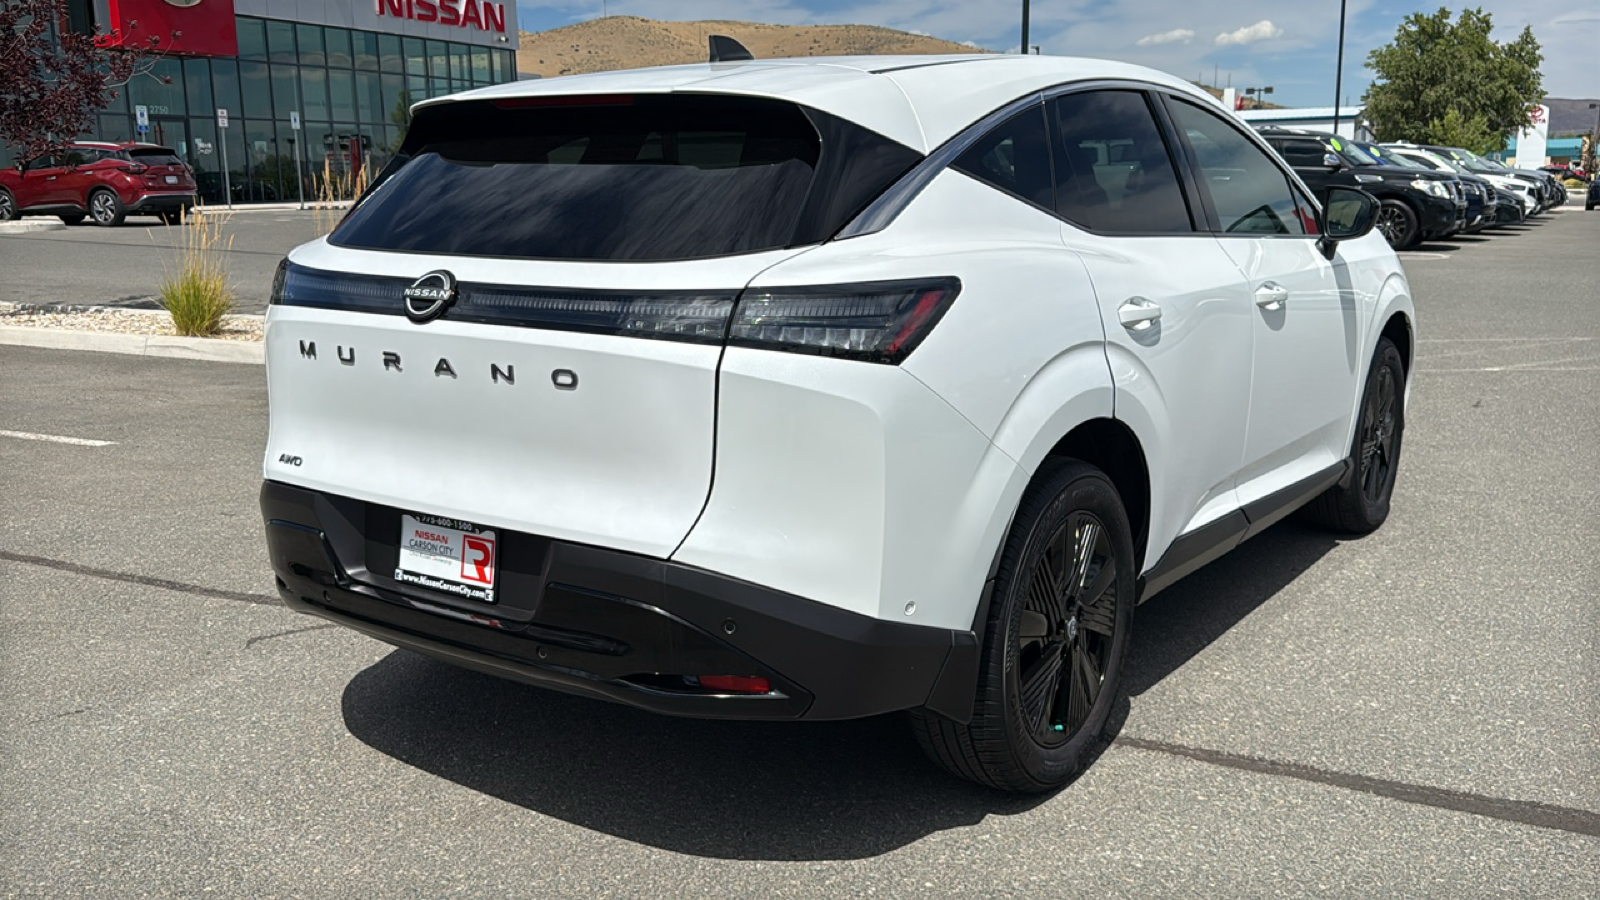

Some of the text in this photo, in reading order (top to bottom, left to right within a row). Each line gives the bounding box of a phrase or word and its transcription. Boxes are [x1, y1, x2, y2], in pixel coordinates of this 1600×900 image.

[376, 0, 505, 33] NISSAN
[149, 105, 169, 114] 2750
[404, 288, 452, 300] NISSAN
[299, 340, 579, 391] MURANO
[278, 453, 303, 467] AWD
[415, 529, 449, 545] NISSAN
[409, 539, 455, 556] CARSON CITY
